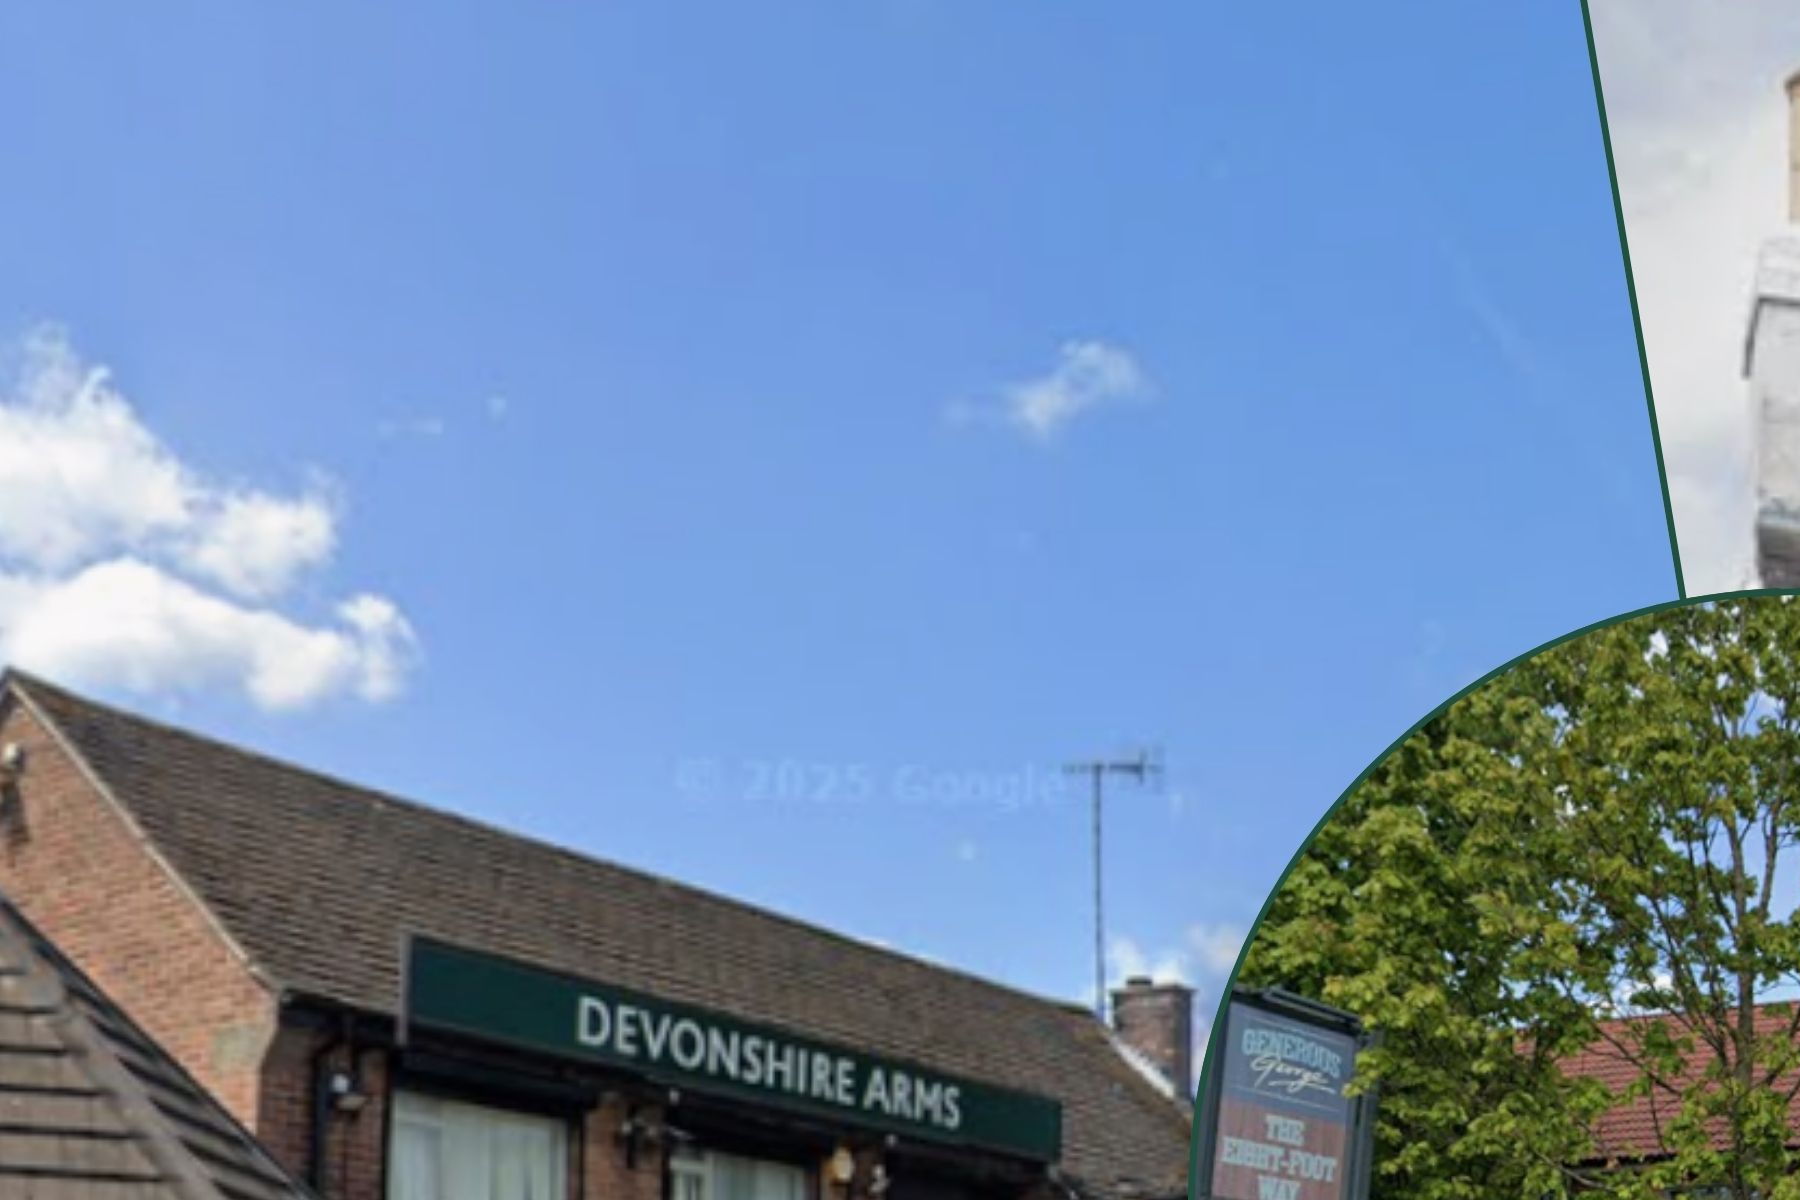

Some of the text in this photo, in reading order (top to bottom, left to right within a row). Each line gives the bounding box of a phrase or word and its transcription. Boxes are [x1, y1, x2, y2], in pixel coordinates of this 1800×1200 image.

[576, 995, 962, 1131] DEVONSHIRE ARMS
[1241, 1028, 1342, 1079] GENEROUS
[1251, 1054, 1337, 1094] George
[1265, 1114, 1304, 1145] THE
[1221, 1136, 1337, 1182] EIGHT-FOOT
